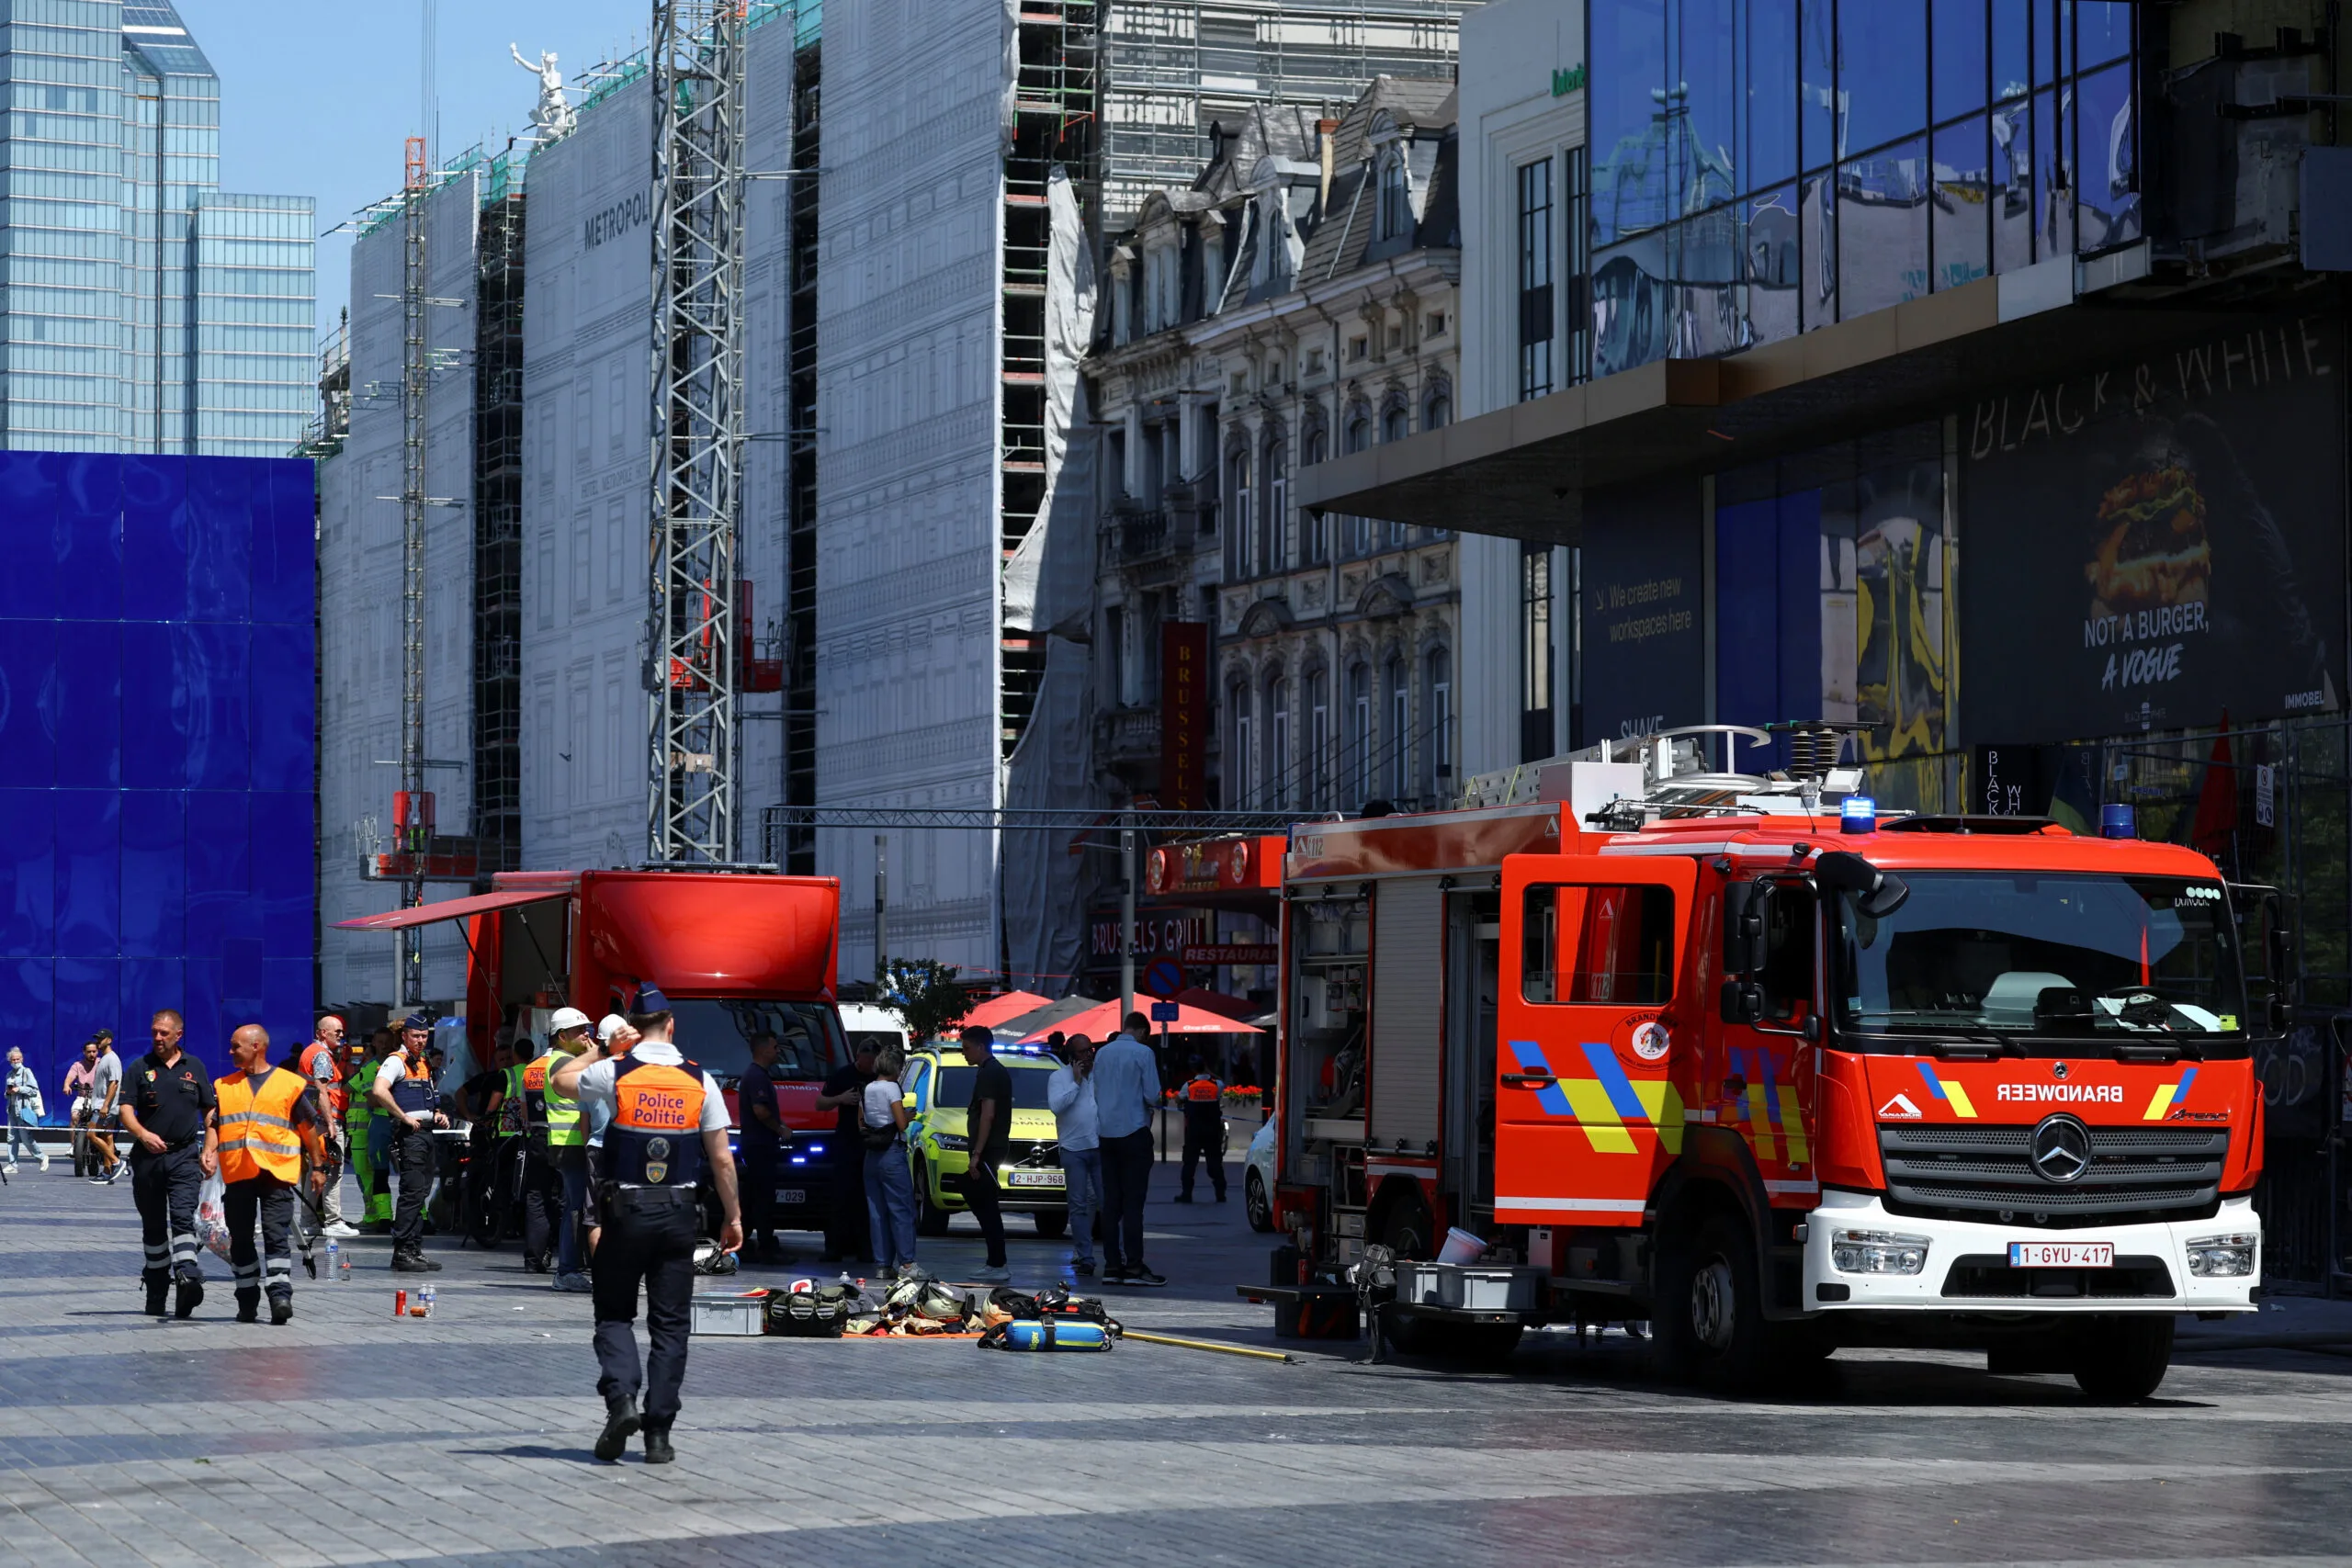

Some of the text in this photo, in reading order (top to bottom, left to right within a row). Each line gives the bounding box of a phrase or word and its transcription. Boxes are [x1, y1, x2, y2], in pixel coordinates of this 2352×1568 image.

[584, 186, 652, 252] METROPOL
[1972, 369, 2110, 460] BLACK
[2175, 315, 2332, 400] WHITE
[1609, 575, 1682, 609] We create new
[1609, 607, 1692, 644] workspaces here
[2084, 600, 2210, 649] NOT A BURGER,
[2100, 642, 2185, 692] A VOGUE
[2284, 689, 2324, 710] IMMOBEL
[1177, 645, 1192, 810] BRUSSELS
[1986, 750, 2000, 816] BLACK
[1091, 919, 1157, 955] BRUSELS
[1184, 948, 1279, 961] RESTAURAN
[528, 1079, 545, 1089] Polit
[529, 1071, 545, 1081] Polic
[633, 1108, 686, 1125] Politie
[638, 1092, 684, 1110] Police
[1015, 1175, 1064, 1184] 2-HJP-968
[2023, 1247, 2110, 1264] 1-GYU-417
